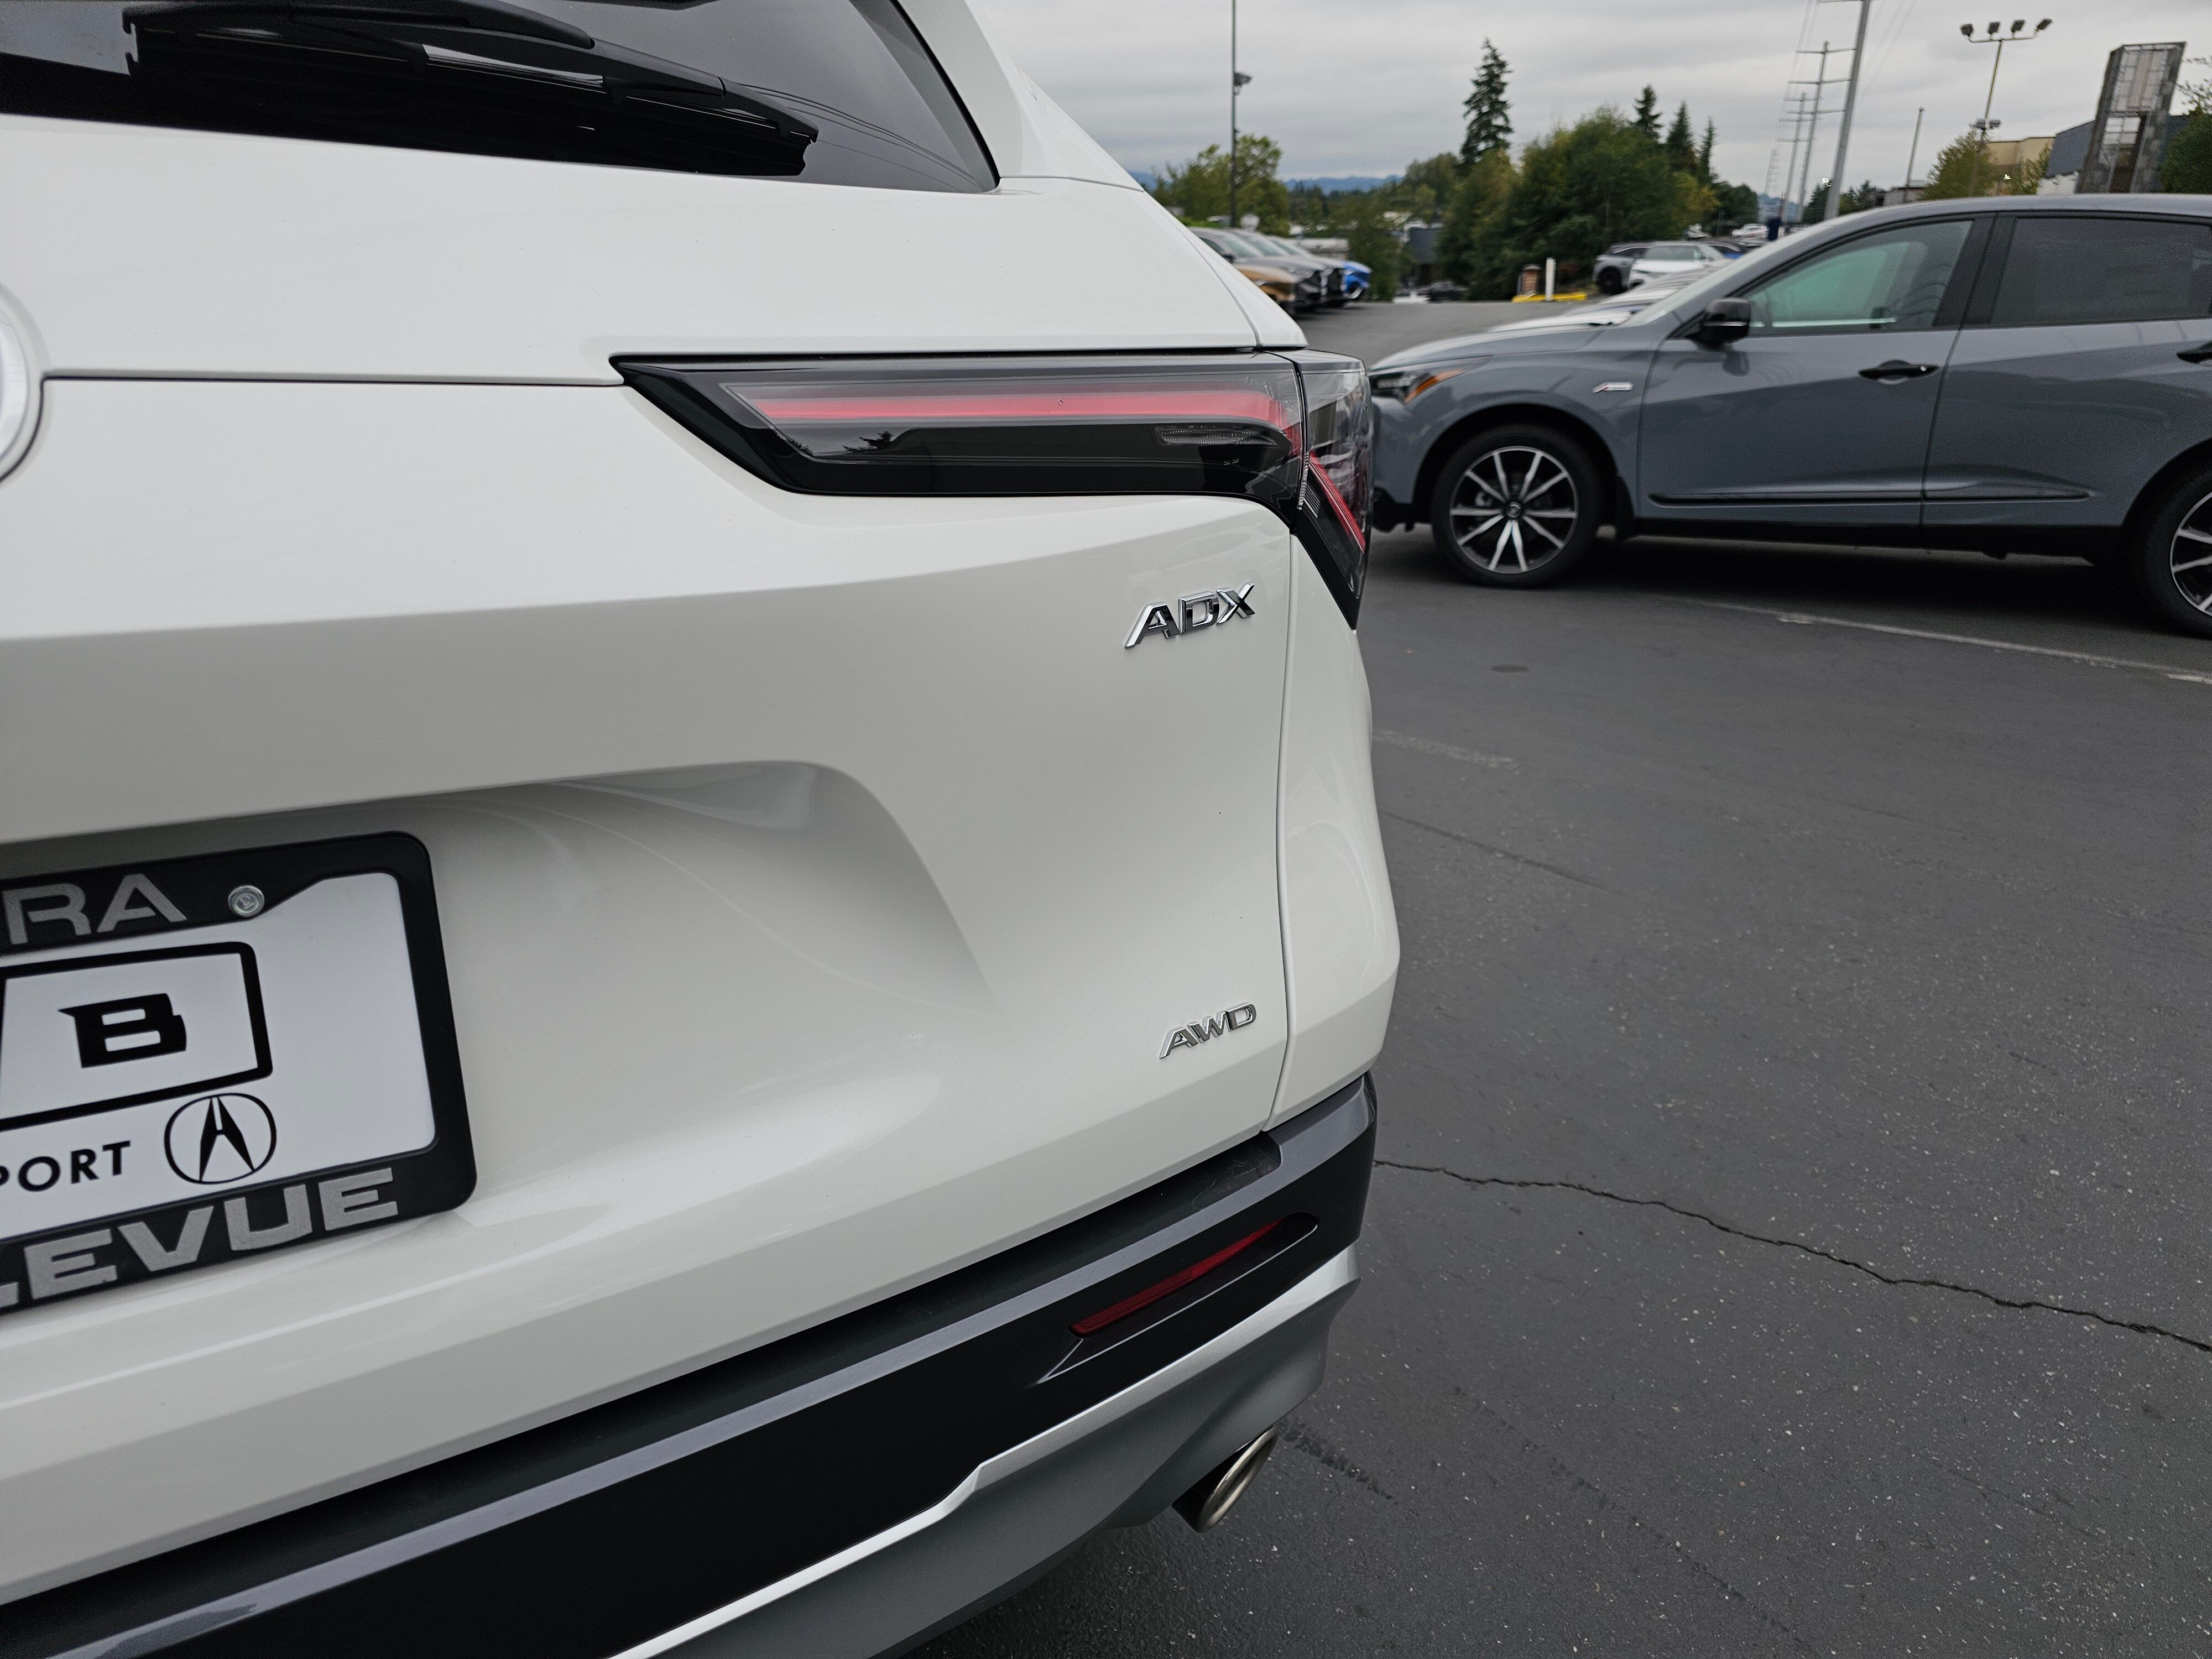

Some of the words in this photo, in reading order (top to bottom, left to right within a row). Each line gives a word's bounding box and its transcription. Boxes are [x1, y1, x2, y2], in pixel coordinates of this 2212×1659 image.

[1124, 581, 1256, 649] ADX
[2, 873, 188, 945] RA
[58, 993, 187, 1069] B
[1159, 1002, 1257, 1060] AWD
